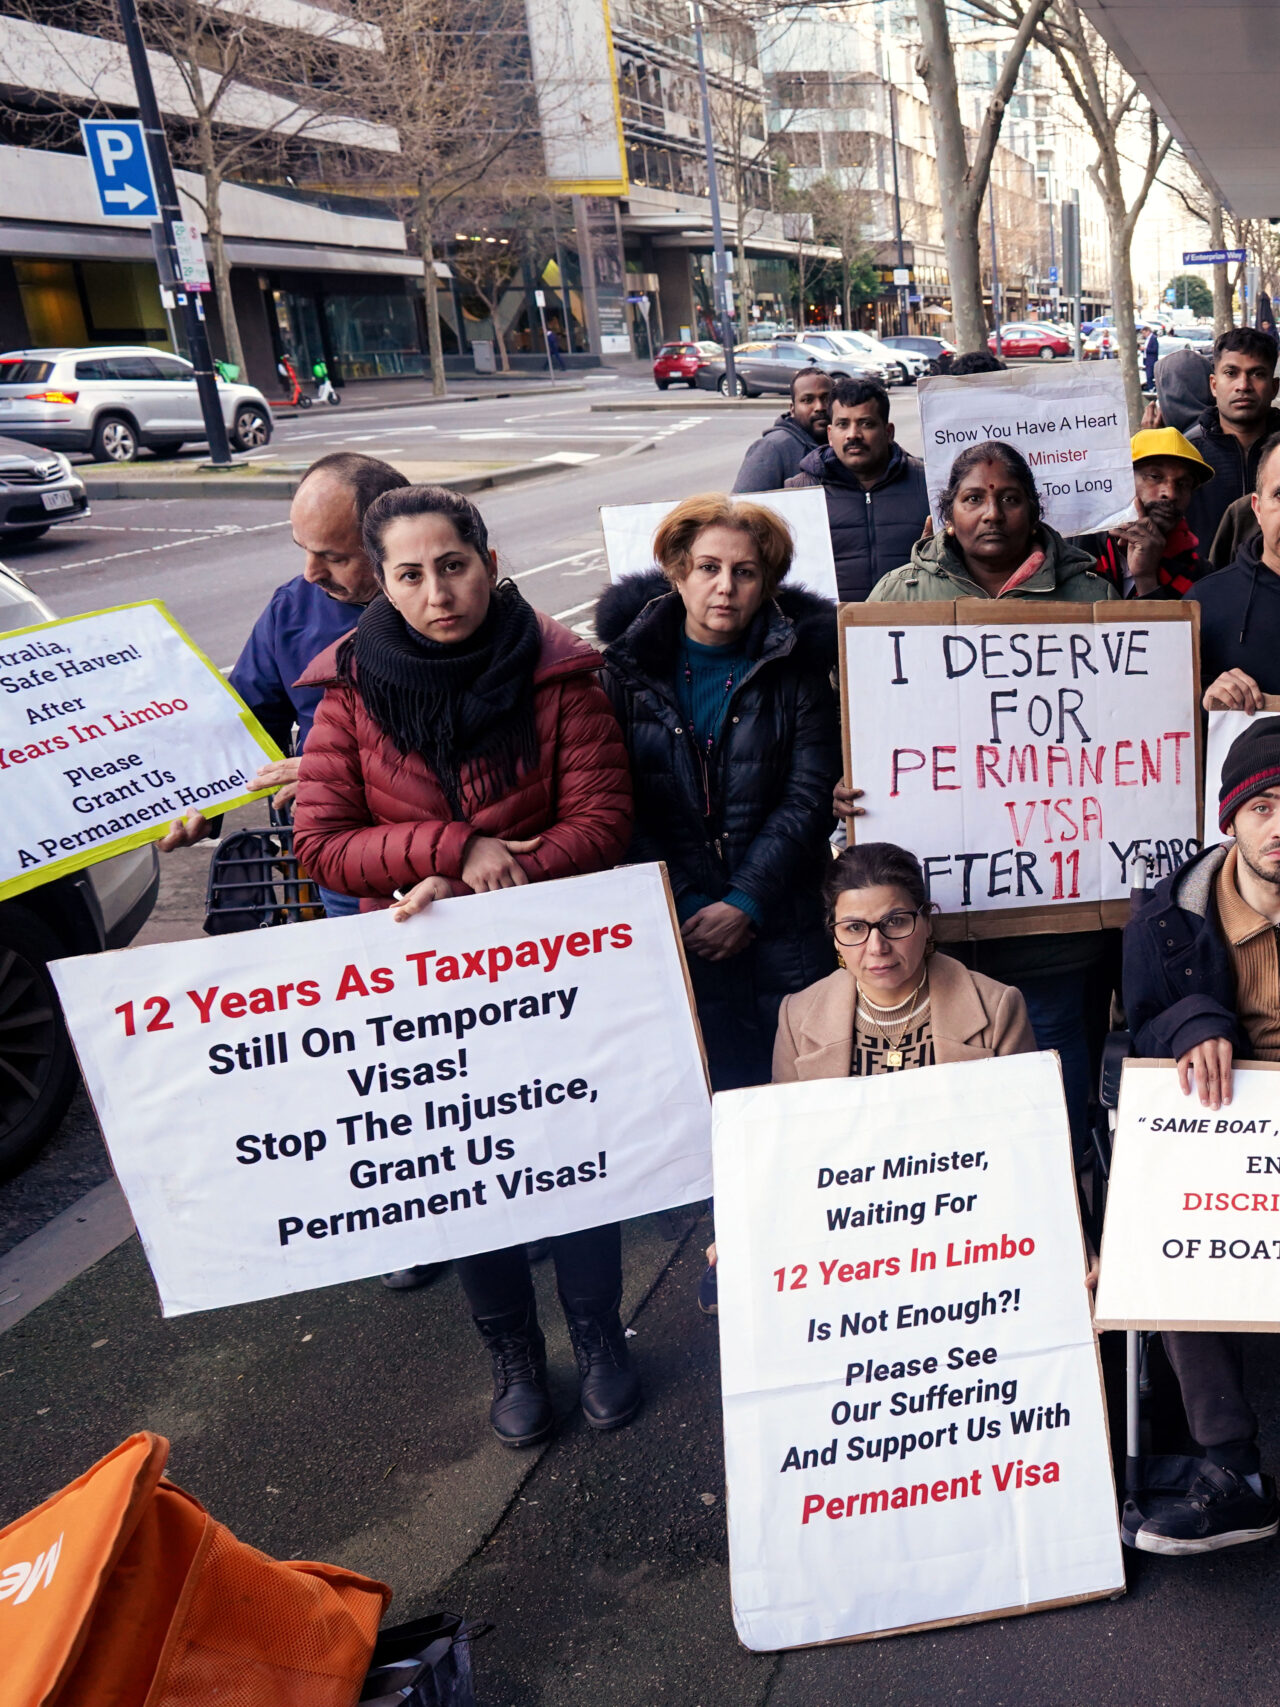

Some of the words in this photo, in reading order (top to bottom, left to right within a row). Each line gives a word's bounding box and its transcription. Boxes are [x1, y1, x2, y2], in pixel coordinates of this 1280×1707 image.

[96, 130, 133, 176] P
[934, 428, 978, 445] Show
[981, 424, 1012, 440] You
[1016, 419, 1056, 436] Have
[1059, 416, 1072, 431] A
[1075, 412, 1118, 429] Heart
[1028, 449, 1088, 467] Minister
[1042, 482, 1070, 496] Too
[1075, 478, 1113, 494] Long
[0, 641, 72, 668] tralia,
[0, 669, 58, 694] Safe
[56, 645, 143, 680] Haven!
[888, 631, 909, 685] I
[943, 630, 1149, 680] DESERVE
[25, 696, 87, 725] After
[67, 725, 108, 745] In
[103, 698, 189, 733] Limbo
[989, 688, 1092, 744] FOR
[63, 754, 144, 788] Please
[889, 731, 1192, 798] PERMANENT
[72, 779, 145, 814] Grant
[141, 769, 176, 790] Us
[17, 849, 41, 869] A
[38, 798, 177, 859] Permanent
[173, 769, 249, 807] Home!
[1004, 796, 1104, 848] VISA
[1050, 849, 1081, 900] 11
[113, 996, 174, 1038] 12
[186, 979, 322, 1025] Years
[335, 964, 396, 1002] As
[406, 922, 635, 990] Taxpayers
[208, 1032, 289, 1076] Still
[301, 1026, 357, 1059] On
[366, 986, 580, 1044] Temporary
[347, 1049, 469, 1098] Visas!
[235, 1125, 328, 1167] Stop
[336, 1112, 413, 1147] The
[423, 1077, 600, 1130] Injustice,
[1150, 1117, 1210, 1134] SAME
[1214, 1119, 1272, 1135] BOAT
[349, 1145, 456, 1190] Grant
[467, 1137, 516, 1166] Us
[816, 1160, 876, 1189] Dear
[882, 1147, 989, 1180] Minister,
[277, 1180, 488, 1247] Permanent
[496, 1151, 609, 1201] Visas!
[826, 1198, 926, 1233] Waiting
[934, 1191, 977, 1218] For
[772, 1264, 808, 1293] 12
[818, 1255, 901, 1288] Years
[910, 1247, 937, 1273] In
[946, 1232, 1036, 1268] Limbo
[1162, 1239, 1201, 1259] OF
[807, 1317, 832, 1343] Is
[839, 1311, 889, 1338] Not
[895, 1288, 1022, 1330] Enough?!
[845, 1355, 939, 1387] Please
[946, 1344, 999, 1371] See
[830, 1399, 881, 1426] Our
[888, 1375, 1019, 1419] Suffering
[780, 1434, 838, 1473] And
[845, 1420, 959, 1464] Support
[965, 1414, 1001, 1440] Us
[1009, 1402, 1072, 1437] With
[800, 1468, 982, 1525] Permanent
[992, 1457, 1061, 1493] Visa
